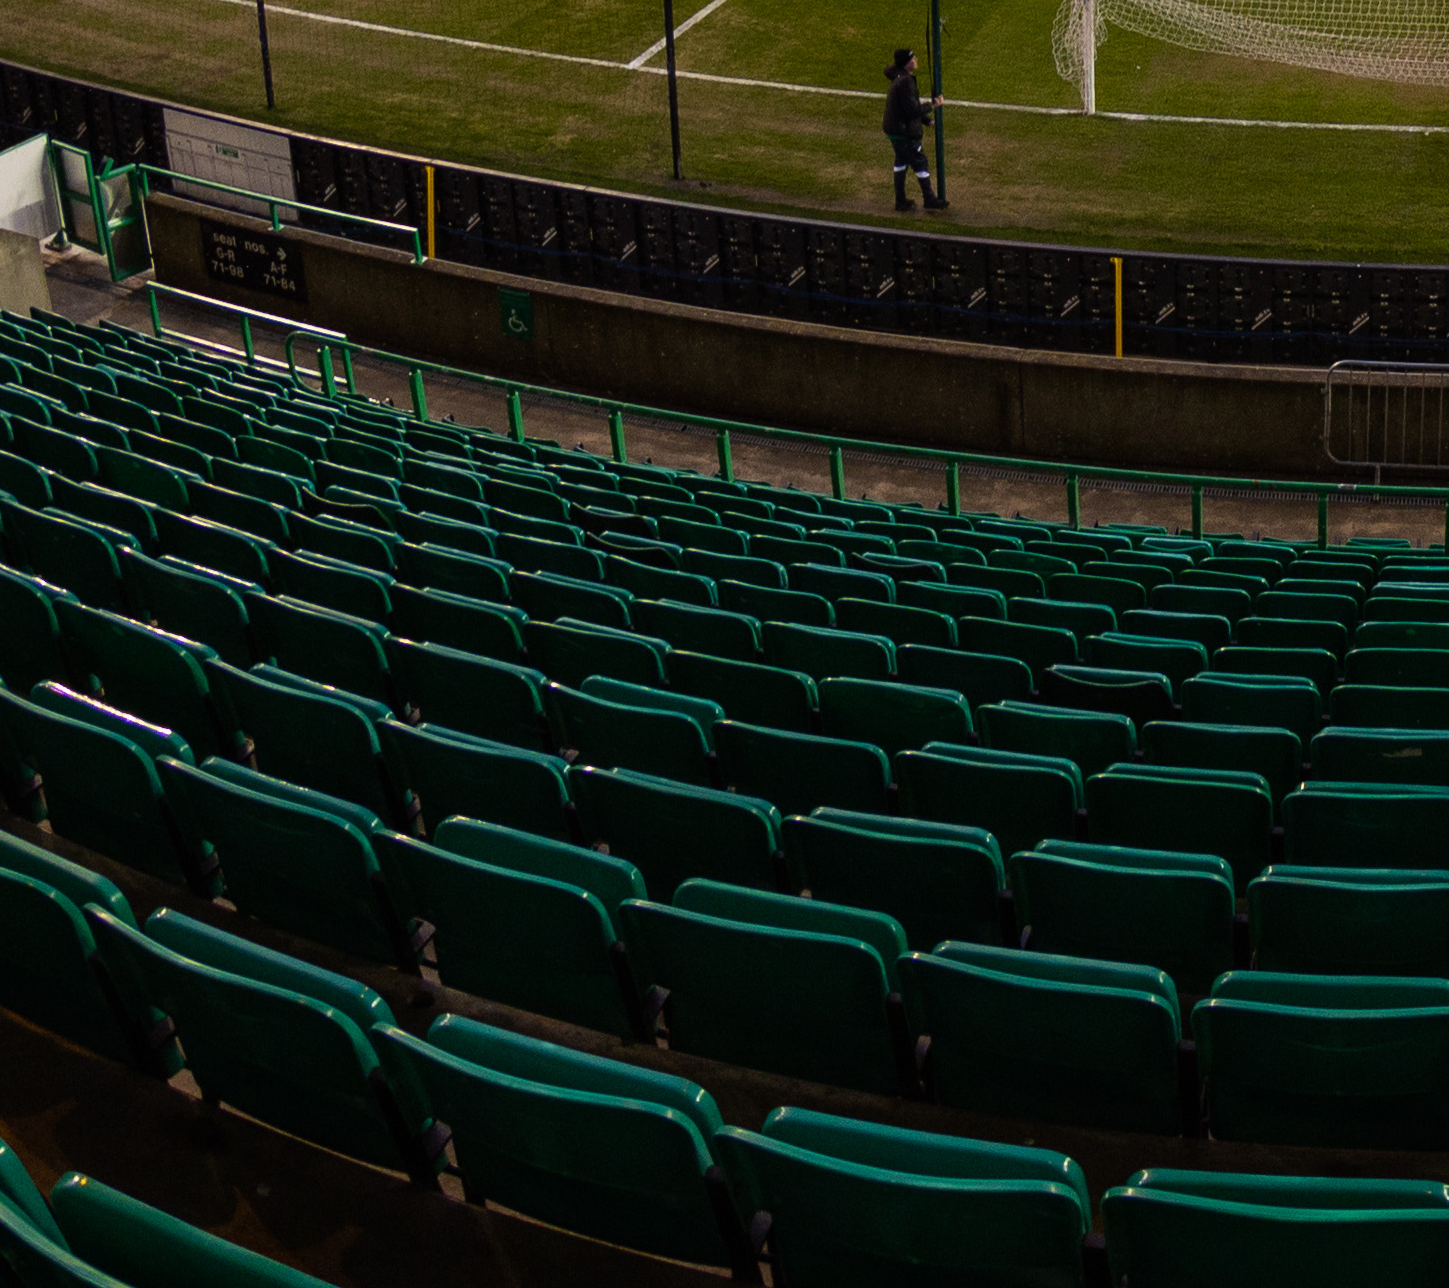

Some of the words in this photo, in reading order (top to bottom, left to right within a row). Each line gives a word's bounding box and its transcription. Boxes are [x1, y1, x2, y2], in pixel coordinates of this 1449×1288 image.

[213, 232, 237, 247] seat
[216, 247, 235, 262] G-R
[271, 261, 287, 275] A-F
[264, 274, 295, 292] 71-84
